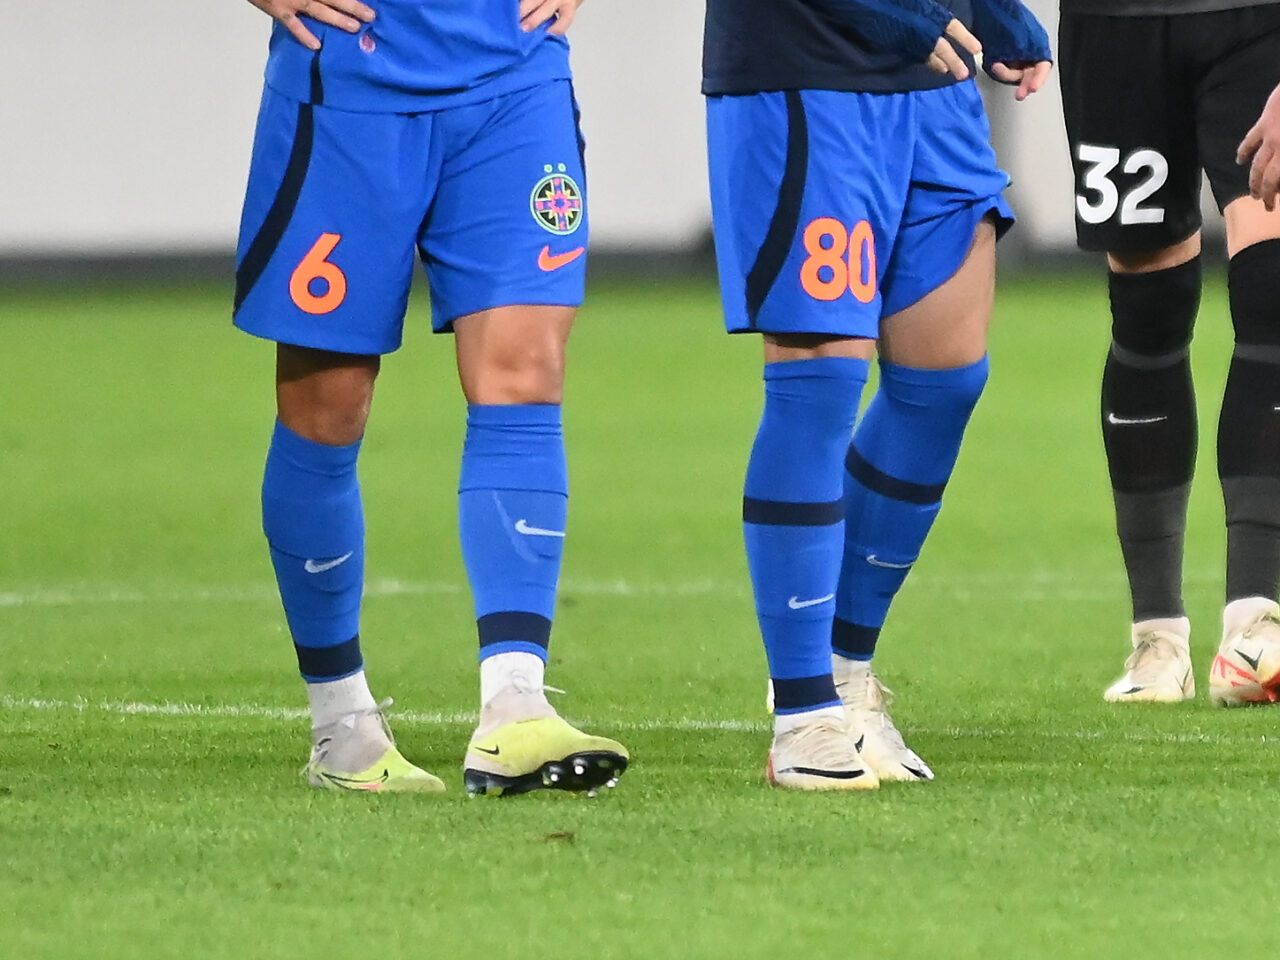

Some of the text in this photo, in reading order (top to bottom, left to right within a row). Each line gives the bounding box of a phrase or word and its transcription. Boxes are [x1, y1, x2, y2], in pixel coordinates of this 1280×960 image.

[1076, 144, 1169, 225] 32
[289, 232, 347, 315] 6
[800, 216, 877, 304] 80
